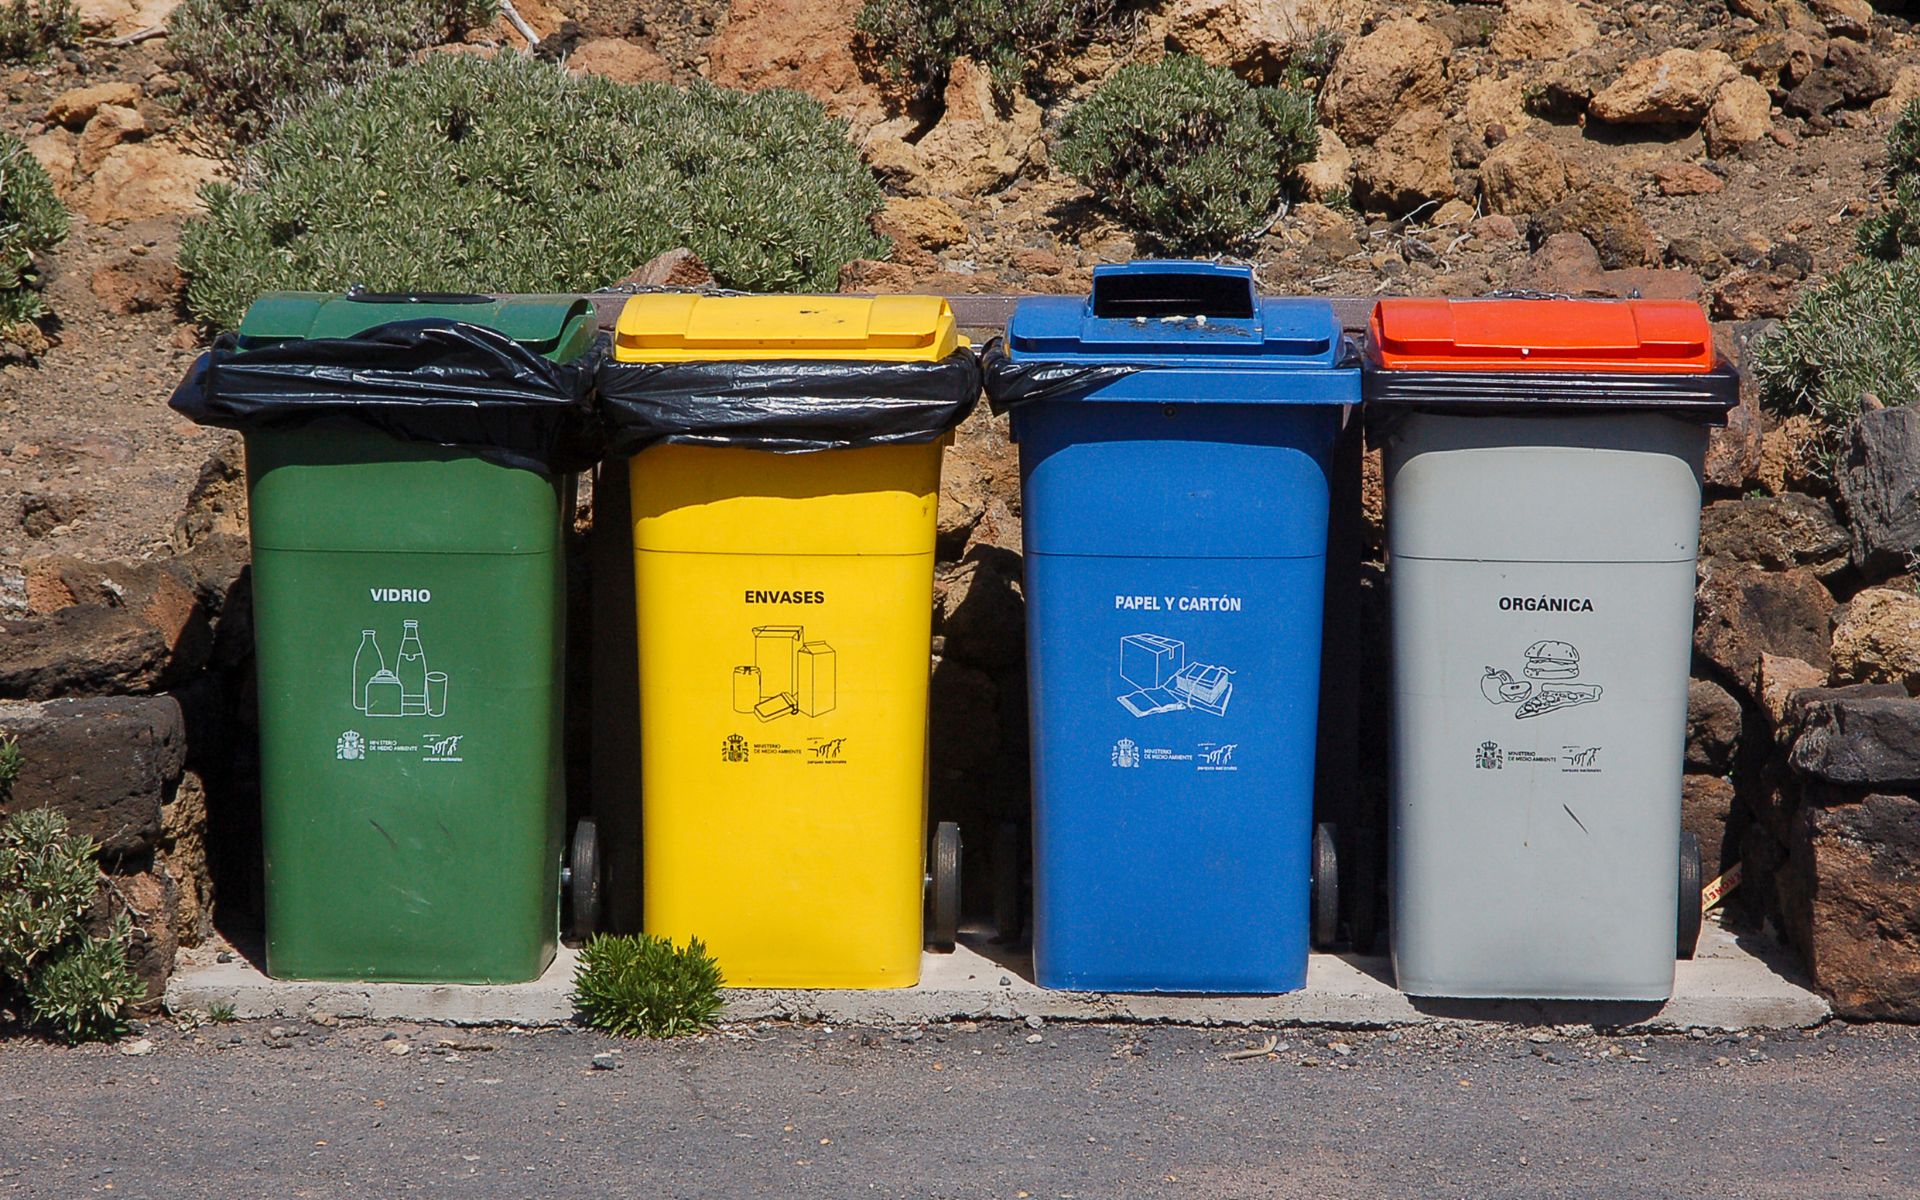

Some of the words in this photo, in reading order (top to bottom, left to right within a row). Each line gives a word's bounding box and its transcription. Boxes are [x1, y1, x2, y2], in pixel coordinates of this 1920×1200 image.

[370, 588, 431, 603] VIDRIO
[744, 590, 825, 605] ENVASES
[1115, 595, 1161, 611] PAPEL
[1164, 596, 1176, 611] Y
[1178, 593, 1242, 612] CARTÓN
[1498, 594, 1594, 612] ORGÁNICA
